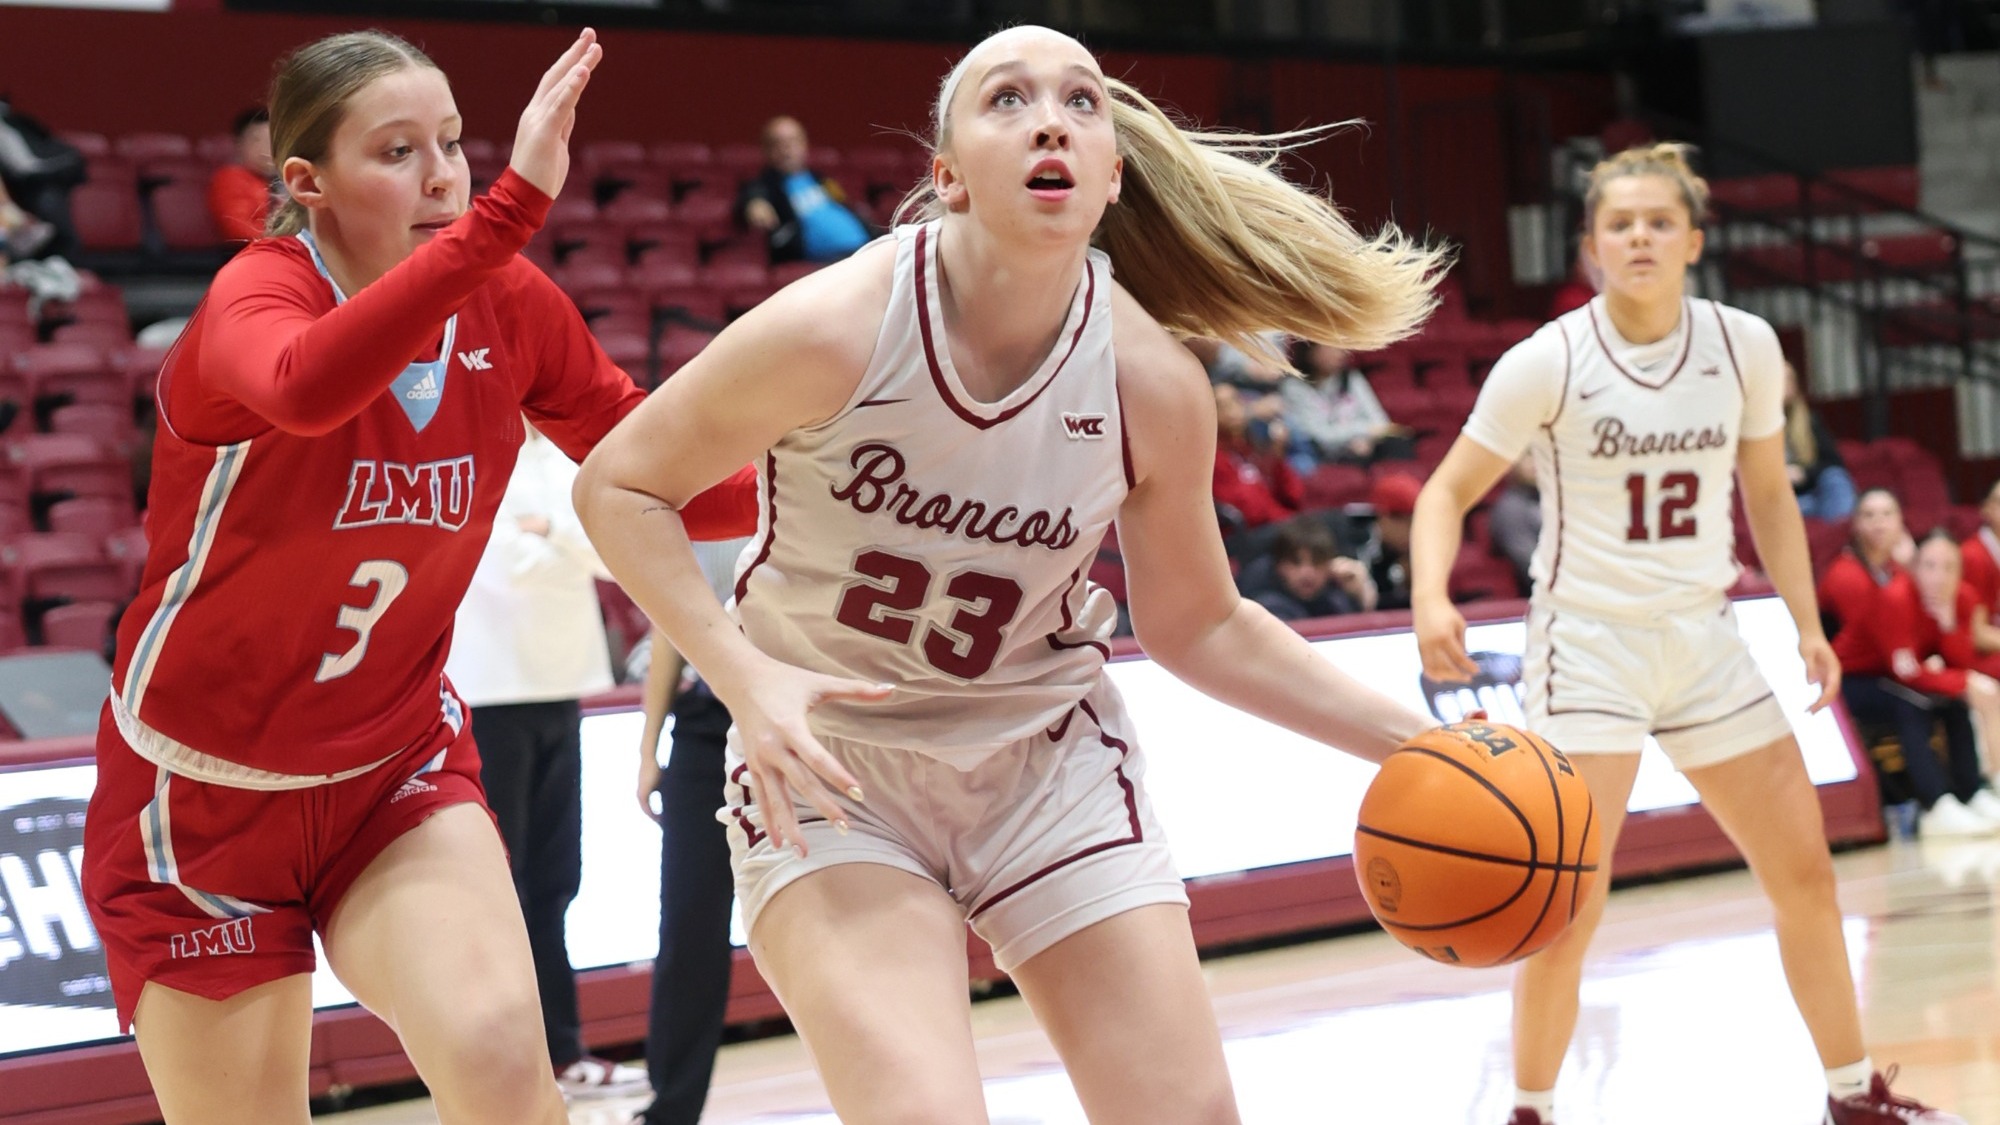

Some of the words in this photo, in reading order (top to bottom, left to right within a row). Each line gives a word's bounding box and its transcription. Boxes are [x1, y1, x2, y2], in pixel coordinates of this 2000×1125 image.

[1590, 417, 1727, 458] Broncos
[332, 454, 476, 532] LMU
[830, 441, 1080, 550] Broncos
[1625, 470, 1700, 541] 12
[314, 560, 409, 683] 3
[834, 548, 1025, 683] 23
[390, 784, 438, 804] adidas
[170, 916, 256, 959] LMU
